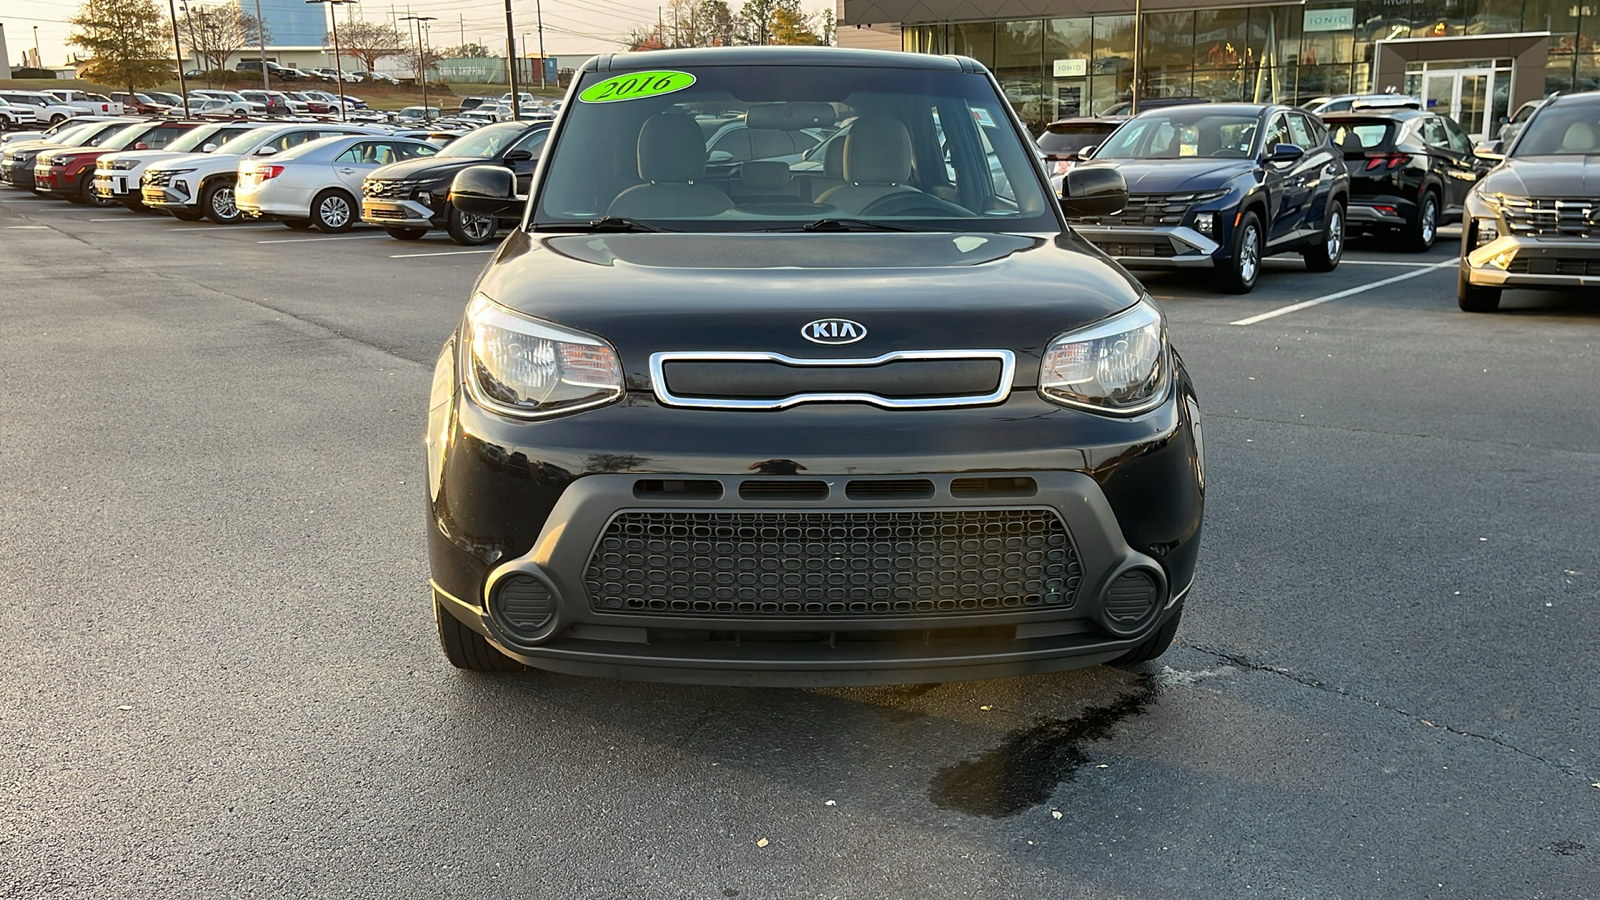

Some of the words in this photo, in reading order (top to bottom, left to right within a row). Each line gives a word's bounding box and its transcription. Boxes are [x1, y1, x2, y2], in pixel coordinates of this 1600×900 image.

[459, 66, 486, 76] SHIPPING
[595, 73, 678, 100] 2016
[812, 322, 857, 338] KIA
